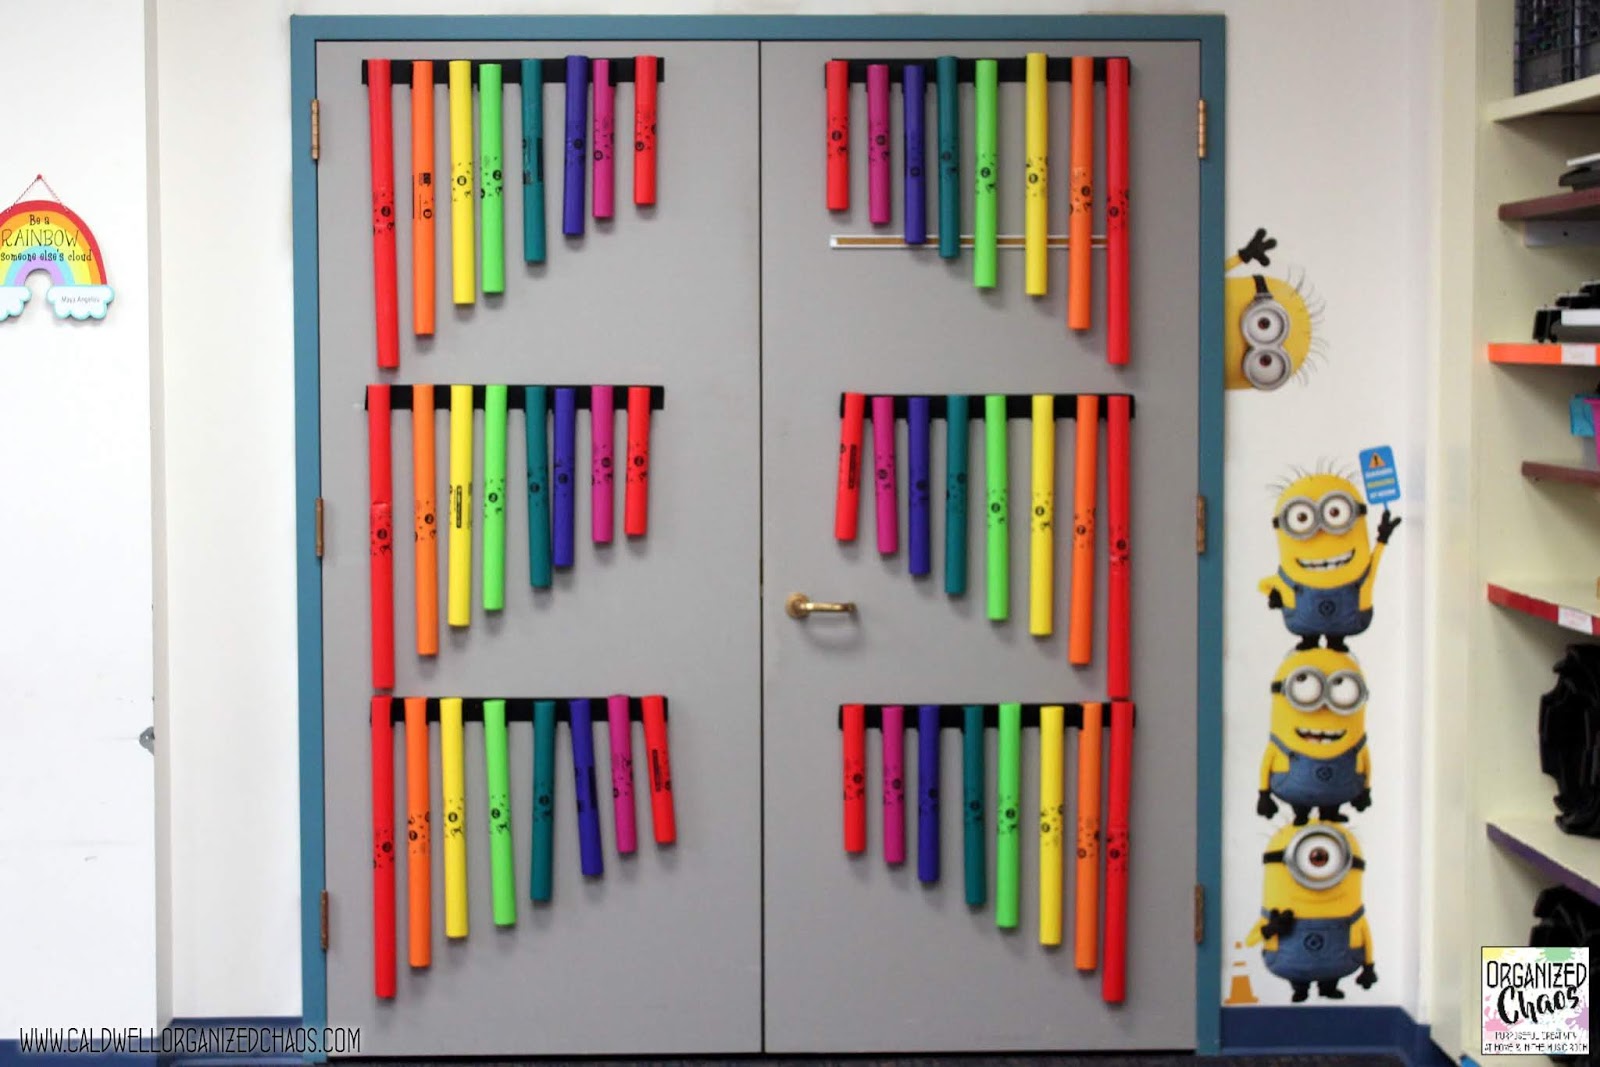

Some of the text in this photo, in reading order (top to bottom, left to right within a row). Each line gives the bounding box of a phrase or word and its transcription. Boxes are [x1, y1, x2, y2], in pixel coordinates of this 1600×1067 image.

[29, 214, 50, 226] Be a
[1, 229, 80, 247] RAINBOW
[0, 249, 92, 262] someone else's cloud
